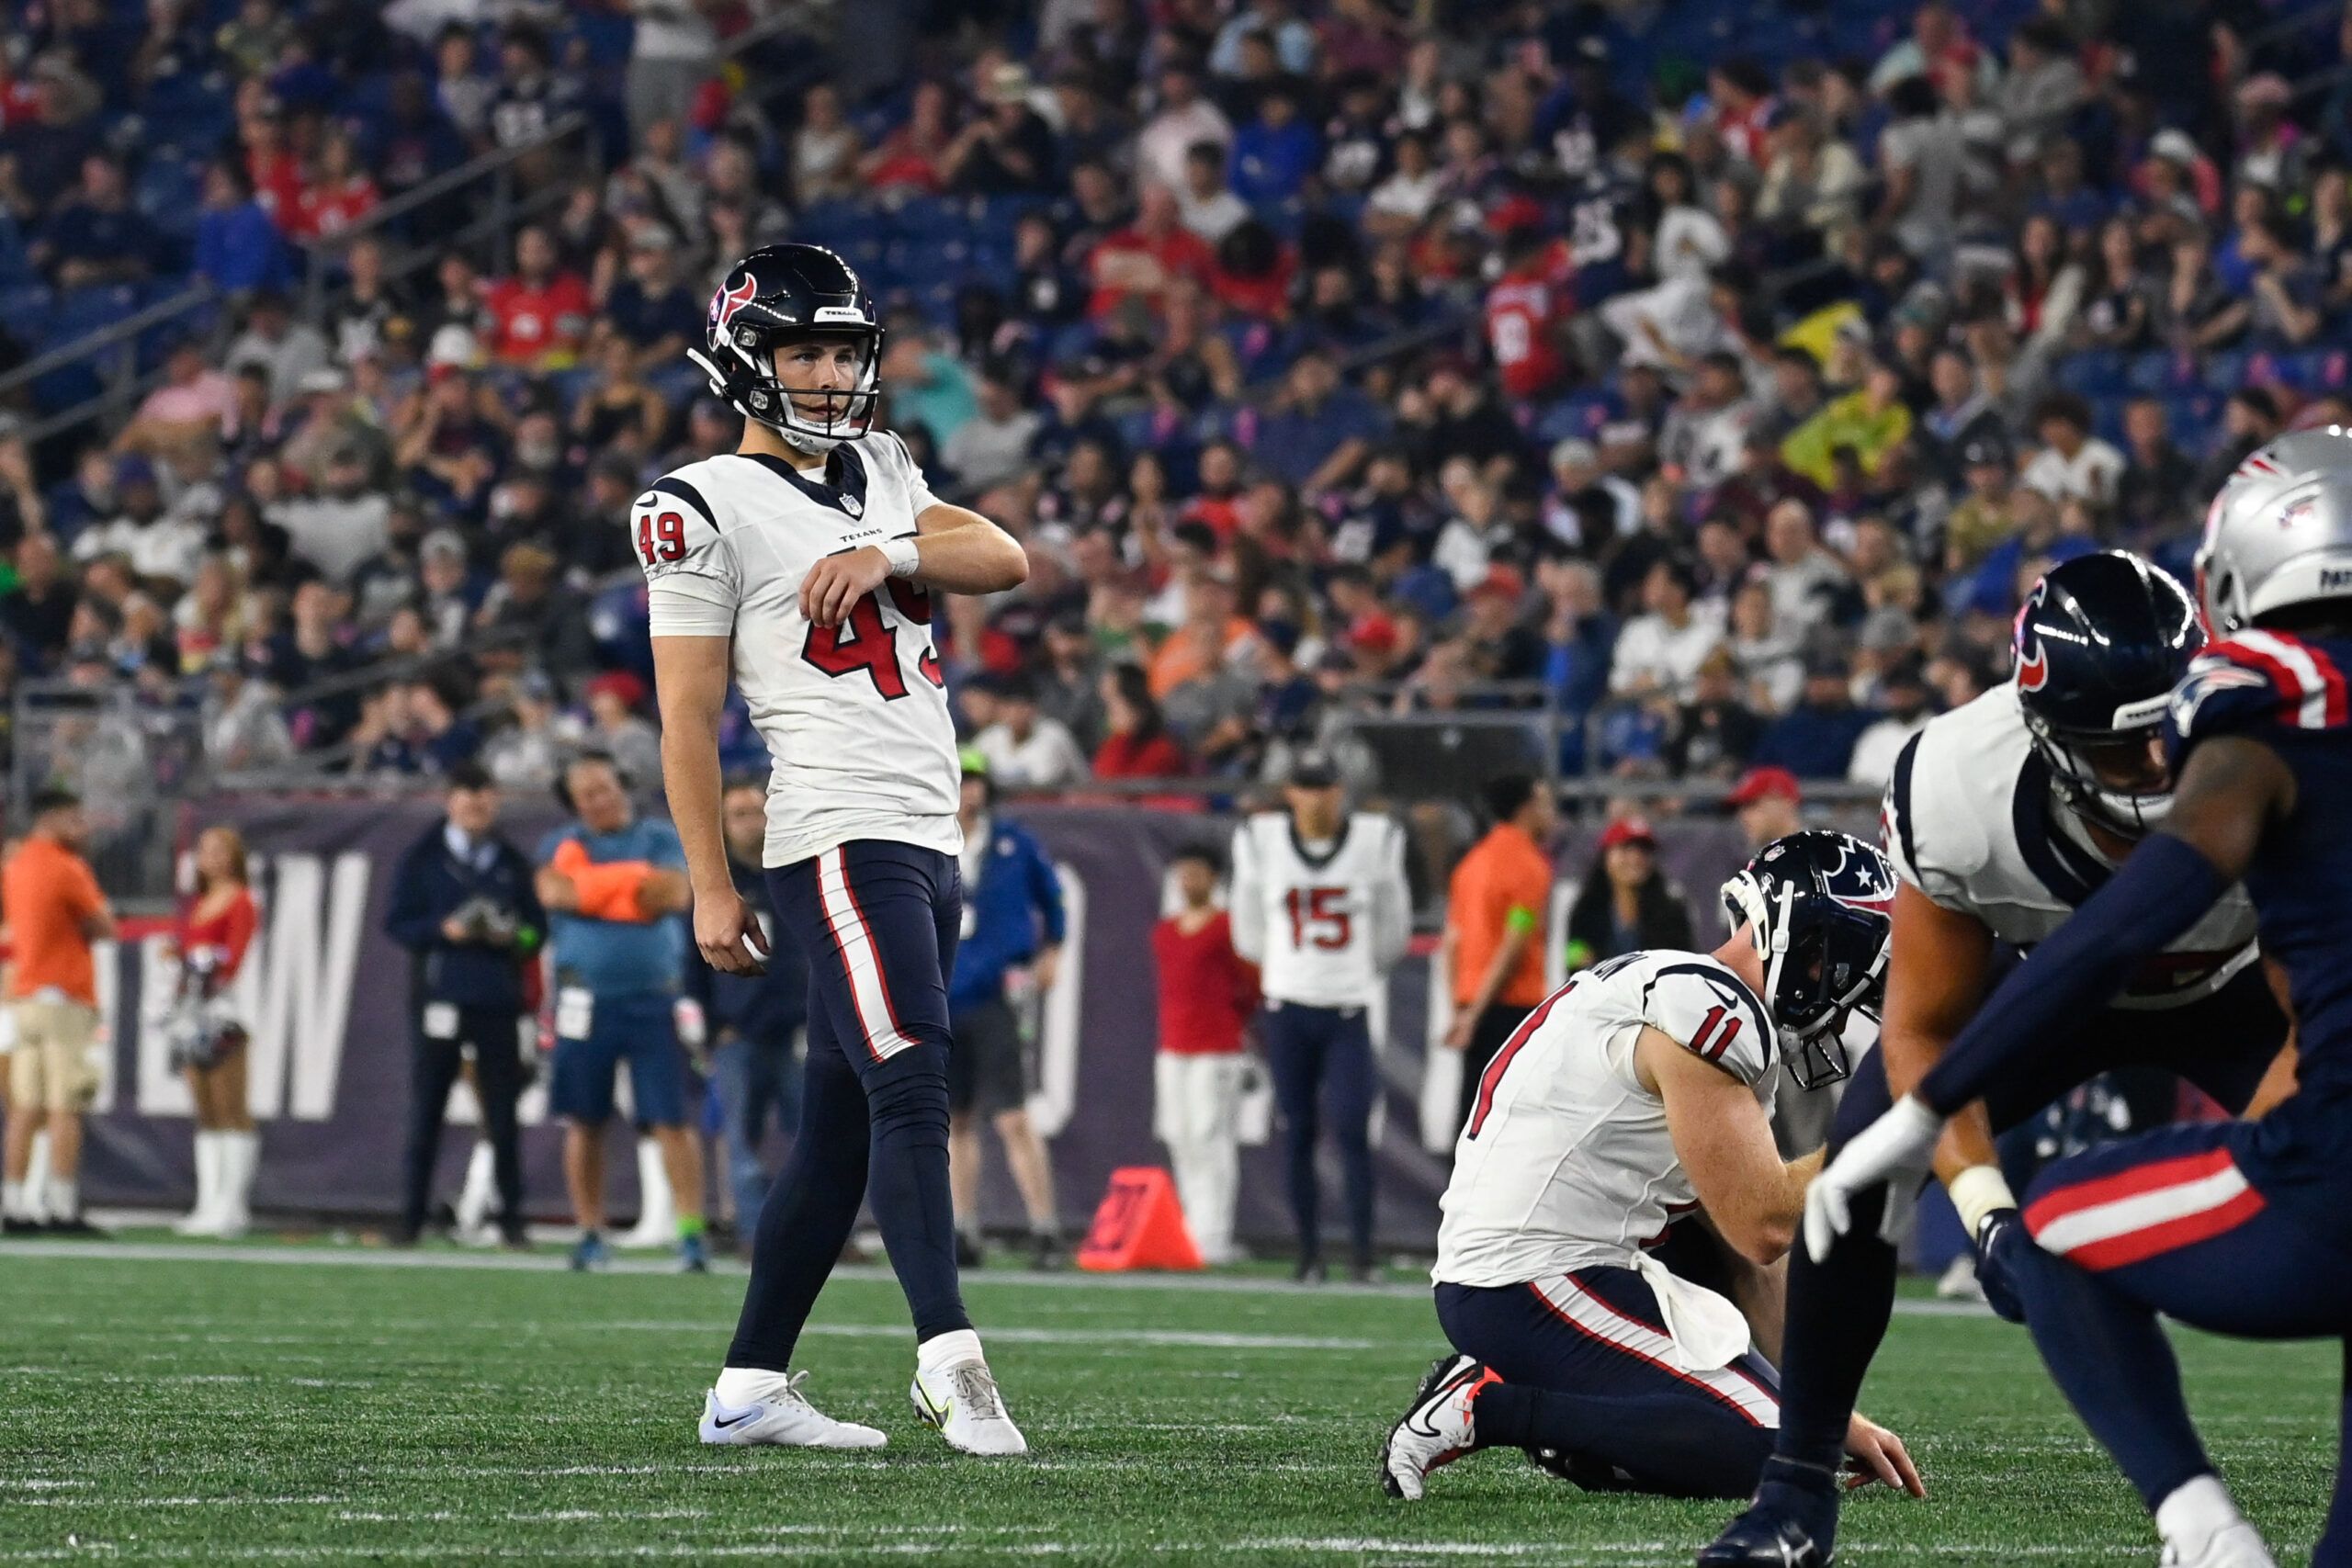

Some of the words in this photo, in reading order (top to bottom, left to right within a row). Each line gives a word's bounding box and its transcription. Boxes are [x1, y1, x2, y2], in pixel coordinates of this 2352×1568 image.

[639, 512, 686, 566] 49
[839, 527, 883, 543] TEXANS
[800, 530, 945, 703] 4
[1283, 885, 1352, 953] 15
[1689, 1004, 1743, 1063] 11
